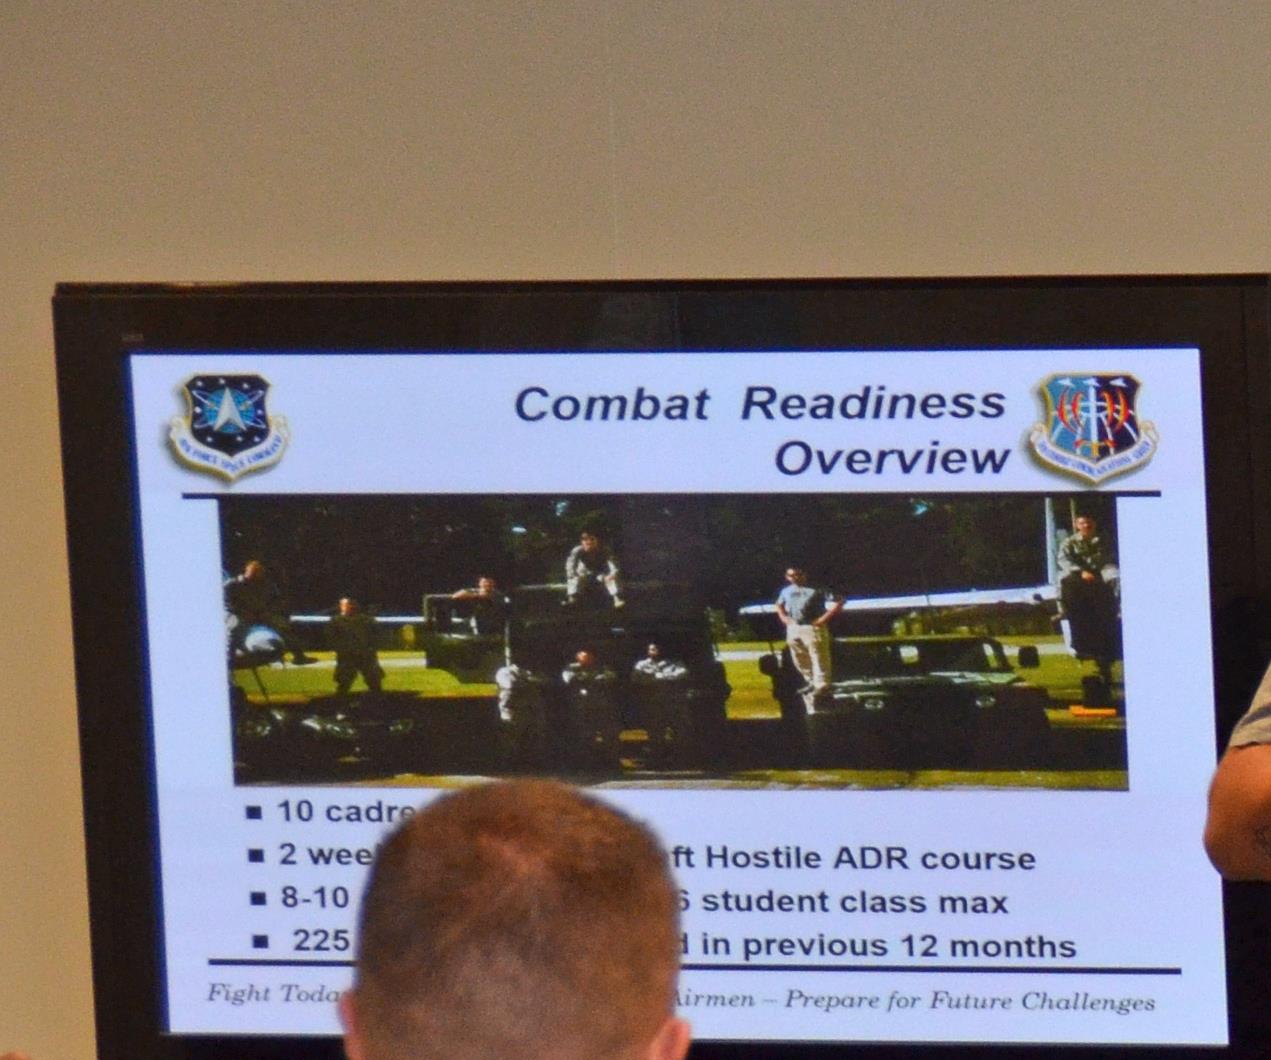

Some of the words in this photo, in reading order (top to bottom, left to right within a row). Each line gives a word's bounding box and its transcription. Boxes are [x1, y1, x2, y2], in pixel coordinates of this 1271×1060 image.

[515, 386, 711, 422] Combat
[741, 385, 1006, 420] Readiness
[774, 440, 1012, 476] Overview
[277, 800, 314, 823] 10
[279, 843, 297, 866] 2
[307, 846, 379, 866] wee
[706, 845, 822, 869] Hostile
[834, 847, 910, 870] ADR
[921, 851, 1036, 870] course
[281, 886, 350, 909] 8-10
[702, 890, 830, 913] student
[840, 891, 927, 913] class
[939, 895, 1009, 914] max
[293, 929, 351, 952] 225
[702, 932, 731, 956] in
[744, 933, 889, 961] previous
[901, 934, 938, 957] 12
[950, 935, 1077, 959] months
[207, 983, 270, 1006] Fight
[281, 984, 342, 1003] Toda
[785, 989, 880, 1012] Prepare
[887, 990, 922, 1012] for
[930, 990, 1013, 1011] Future
[1021, 991, 1156, 1015] Challenges
